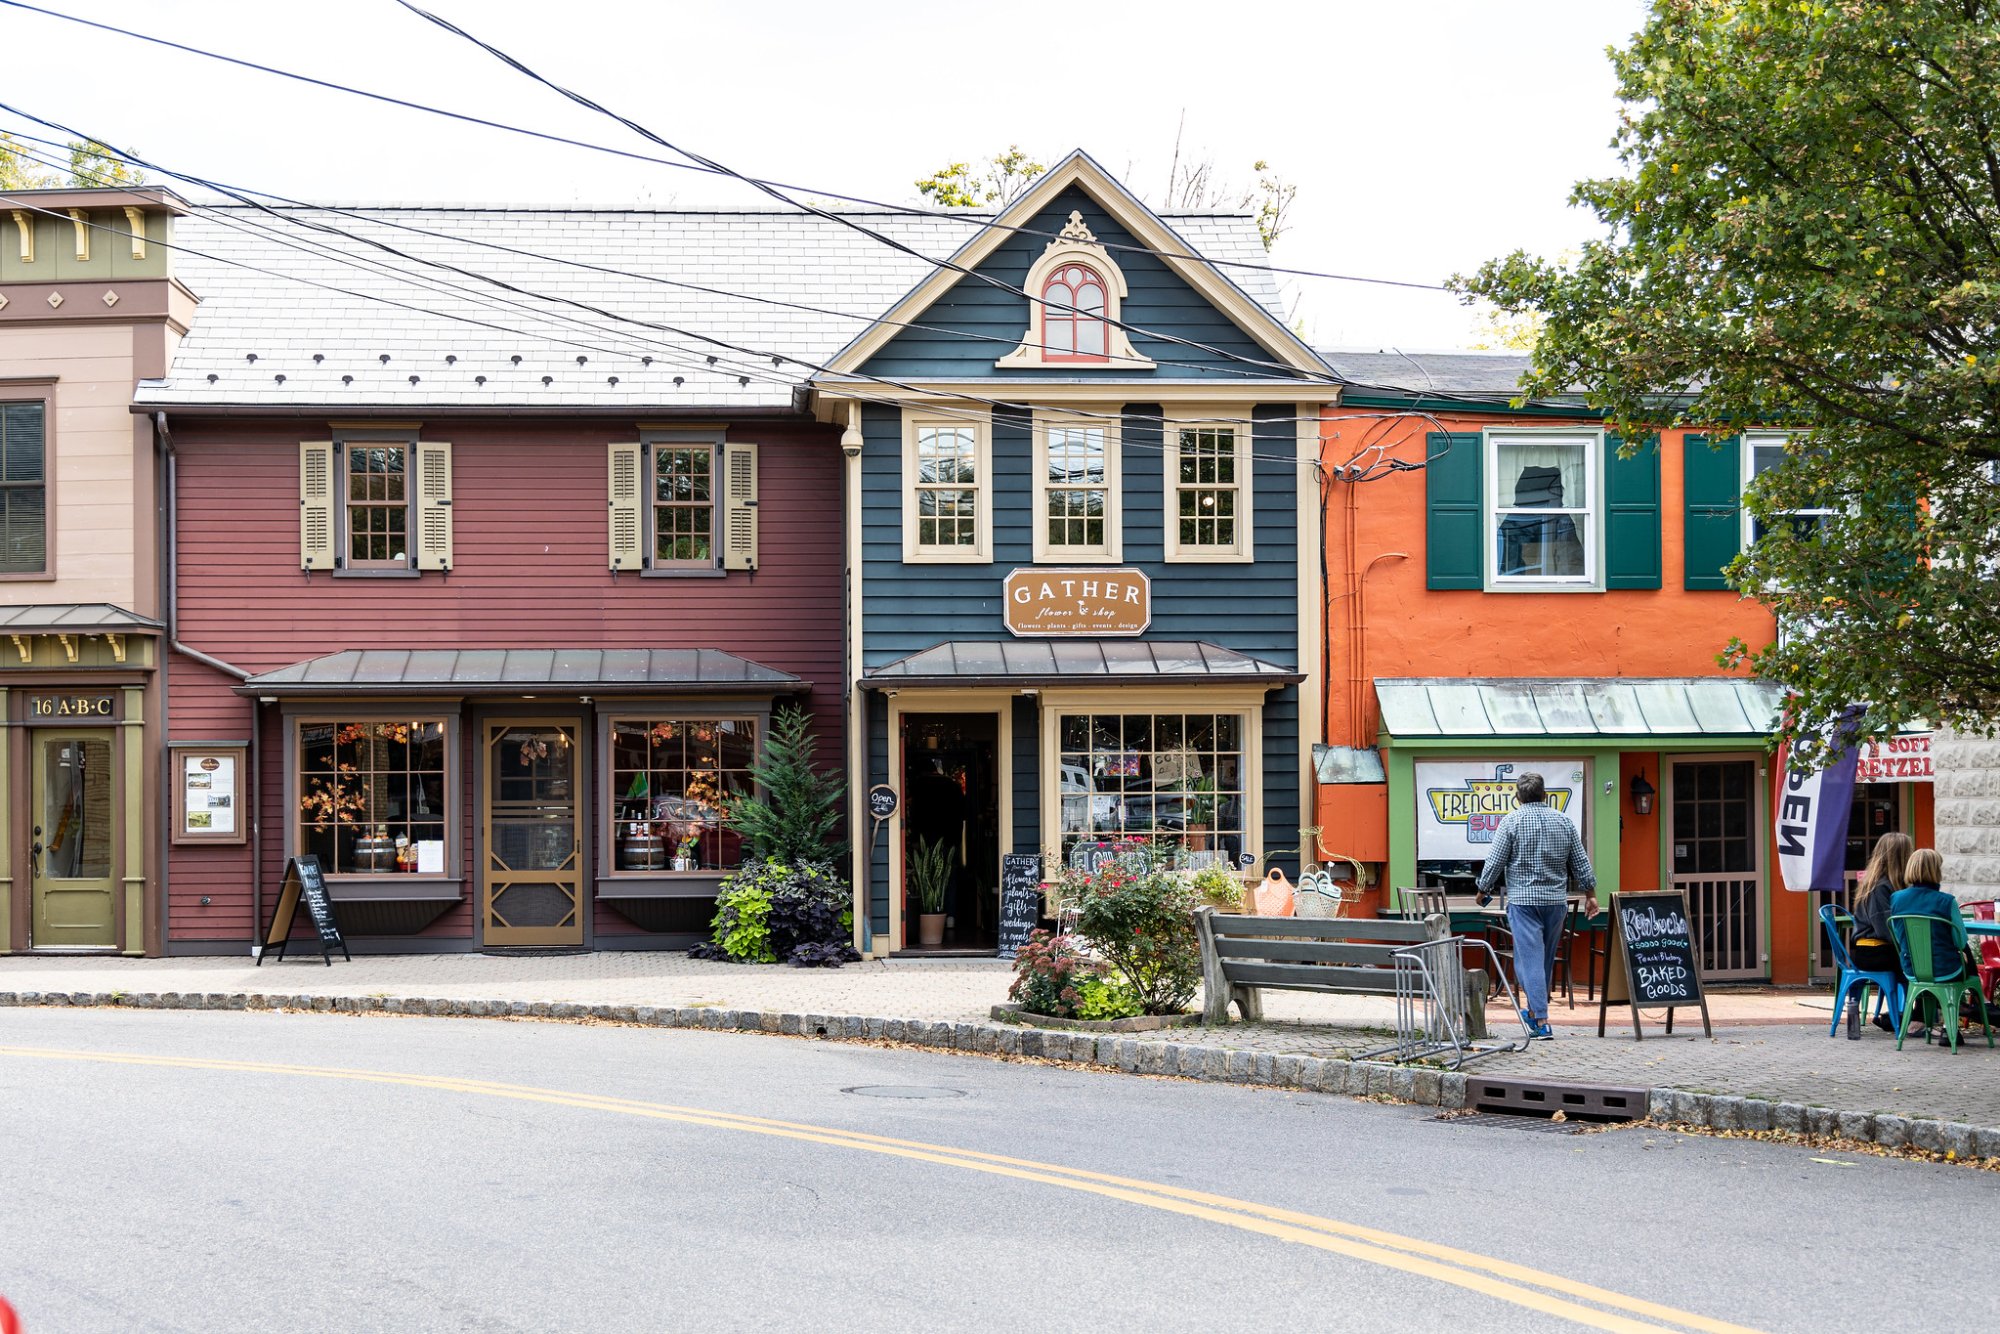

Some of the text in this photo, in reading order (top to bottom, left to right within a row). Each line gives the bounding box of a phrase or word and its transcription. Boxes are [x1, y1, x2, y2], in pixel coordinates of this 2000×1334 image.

[1013, 580, 1140, 605] GATHER
[1035, 607, 1073, 620] flower
[1092, 606, 1116, 619] shop
[1047, 622, 1066, 630] plants
[1072, 622, 1086, 630] gifts
[1119, 622, 1138, 630] design
[36, 699, 52, 715] 16
[1888, 738, 1930, 753] SOFT
[1857, 757, 1934, 777] RETZEL
[871, 793, 895, 804] Open
[1442, 793, 1558, 819] FRENCHTON
[1470, 815, 1502, 831] SU
[1470, 831, 1496, 841] DELIC
[1005, 857, 1034, 866] GATHER
[1007, 873, 1032, 888] flowers
[1005, 886, 1029, 903] plants
[1007, 899, 1027, 917] gifts
[1003, 918, 1031, 931] weddings
[1637, 966, 1687, 988] BAKED
[1647, 984, 1687, 999] GOODS
